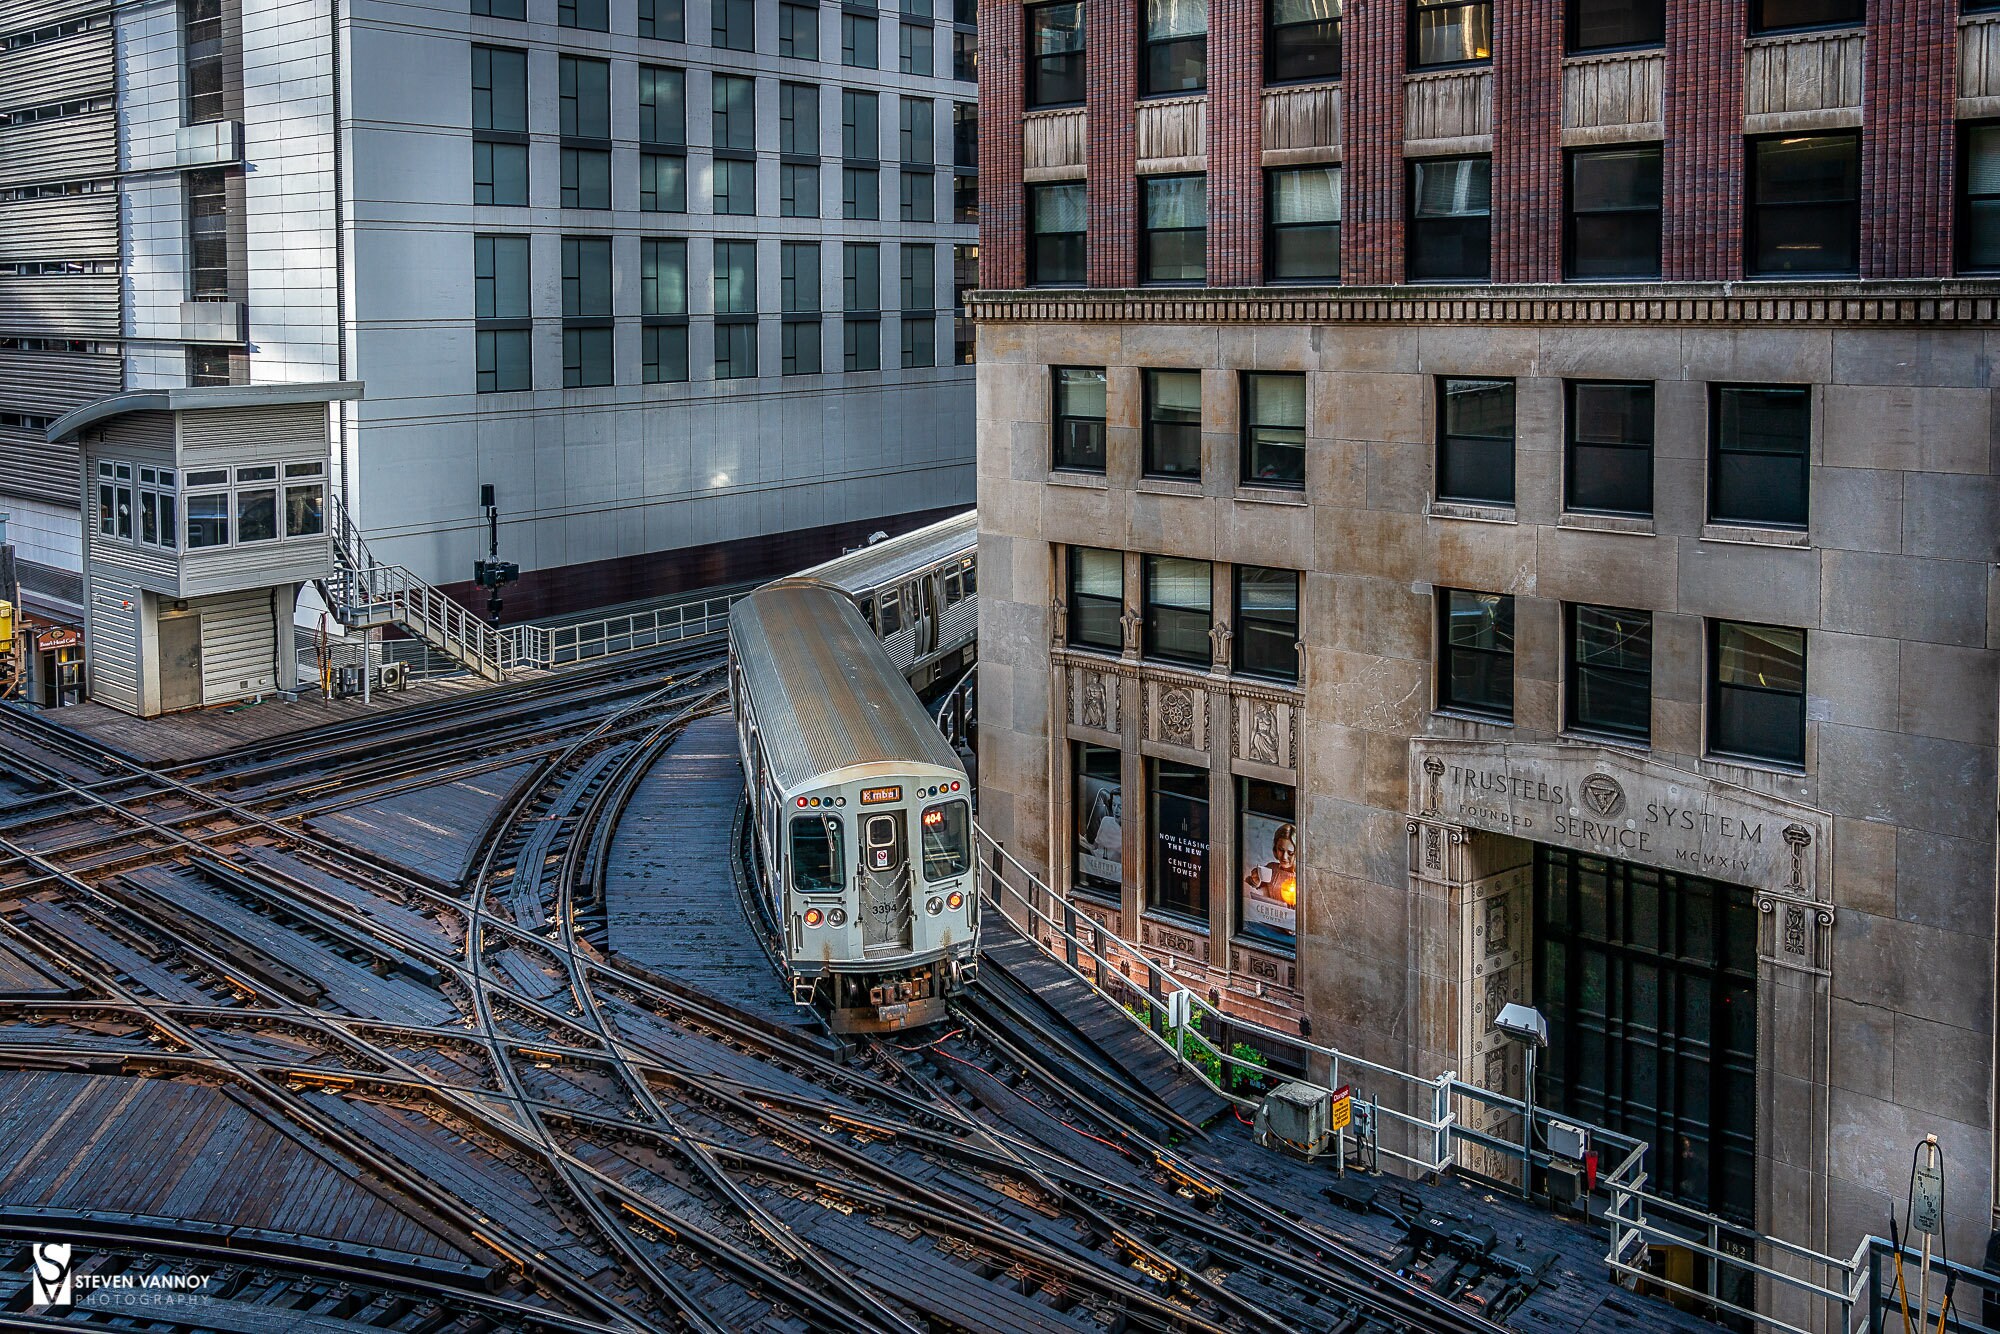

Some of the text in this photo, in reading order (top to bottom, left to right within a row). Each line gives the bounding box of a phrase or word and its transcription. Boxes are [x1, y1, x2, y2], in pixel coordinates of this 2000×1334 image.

[1450, 766, 1563, 804] TRUSTEES
[1645, 803, 1762, 844] SYSTEM
[925, 812, 941, 824] 404
[1459, 804, 1533, 828] FOUNDED
[1554, 815, 1651, 853] SERVICE
[1160, 833, 1210, 851] NOW LEASING
[1168, 842, 1202, 856] THE NEW
[1168, 857, 1202, 872] CENTURY
[1675, 848, 1749, 871] MCMXIV
[1172, 866, 1198, 879] TOWER
[872, 904, 897, 914] 3394
[1256, 904, 1288, 920] CENTURY
[1726, 1241, 1746, 1256] 182
